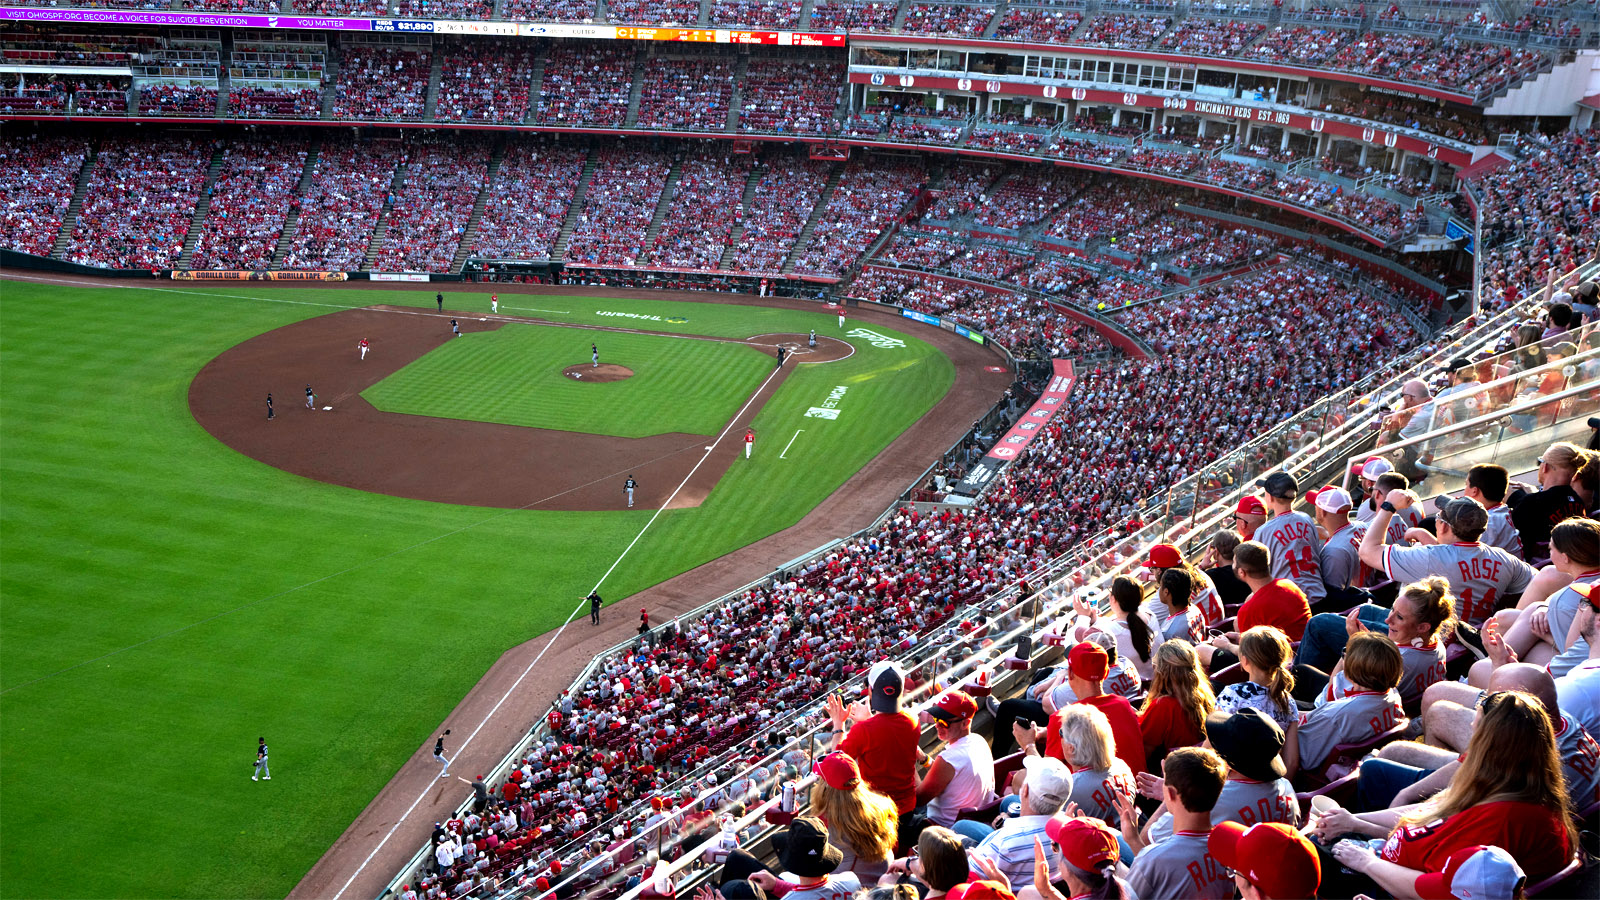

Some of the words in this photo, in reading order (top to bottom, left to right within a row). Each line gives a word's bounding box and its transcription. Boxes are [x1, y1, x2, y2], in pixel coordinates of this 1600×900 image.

[27, 11, 82, 20] OHIOSPF.ORG
[83, 13, 117, 21] BECOME
[125, 14, 149, 22] VOICE
[167, 16, 198, 24] SUICIDE
[199, 17, 248, 25] PREVENTION
[298, 19, 314, 27] YOU
[397, 22, 433, 31] $21,890
[872, 73, 883, 85] 42
[989, 81, 999, 92] 20
[1125, 93, 1136, 105] 24
[1194, 101, 1233, 116] CINCINNATI
[1234, 106, 1252, 119] REDS
[1257, 110, 1274, 122] EST.
[1275, 112, 1290, 125] 1869
[196, 271, 223, 279] GORILLA
[224, 271, 240, 279] GLUE
[277, 272, 303, 280] GORILLA
[305, 272, 321, 280] TAPE
[1273, 521, 1310, 546] ROSE
[1350, 526, 1368, 550] ROS
[1388, 523, 1408, 543] ROS
[1284, 545, 1319, 579] 14
[1458, 558, 1502, 583] ROSE
[1196, 592, 1223, 626] 14
[1460, 587, 1497, 623] 14
[1369, 703, 1405, 735] ROS
[1091, 773, 1131, 813] ROSE
[1238, 795, 1293, 827] ROSE
